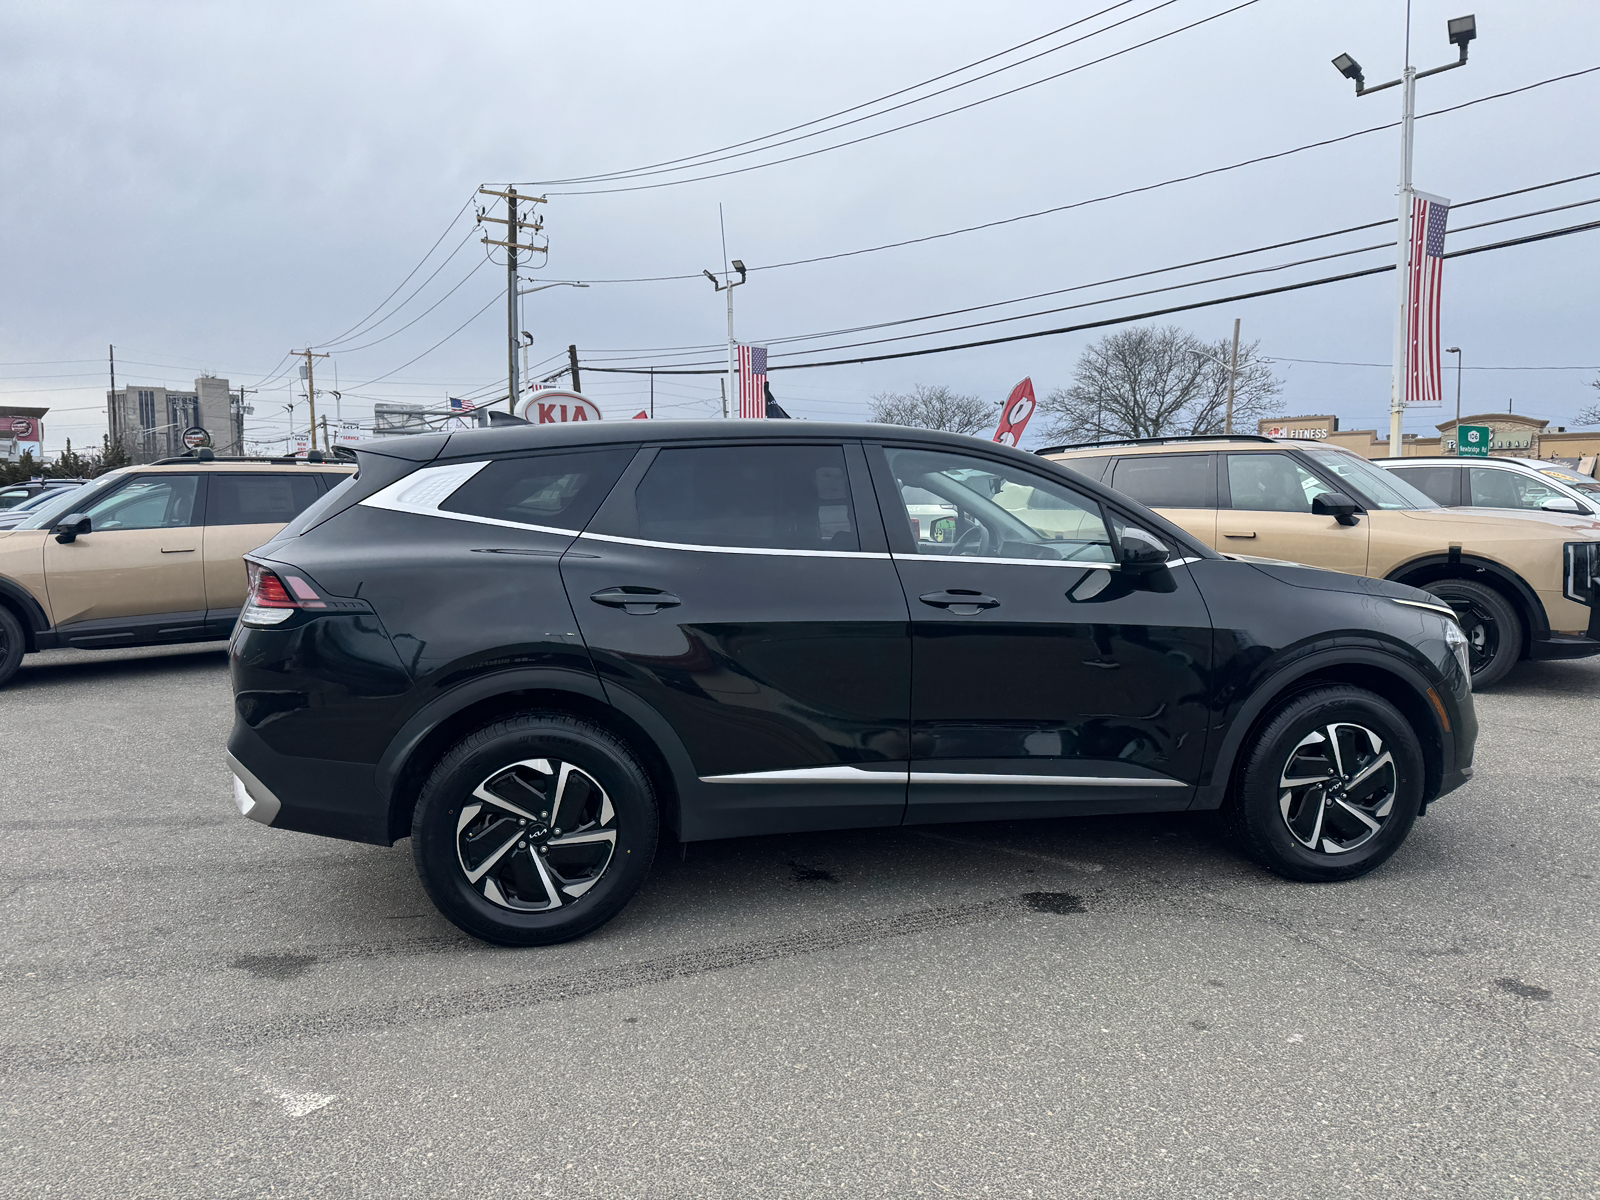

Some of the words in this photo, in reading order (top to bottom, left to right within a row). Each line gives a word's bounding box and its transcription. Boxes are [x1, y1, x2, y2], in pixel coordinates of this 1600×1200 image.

[537, 403, 588, 424] KIA
[1290, 428, 1328, 439] FITNESS
[1460, 445, 1480, 453] Newbridge
